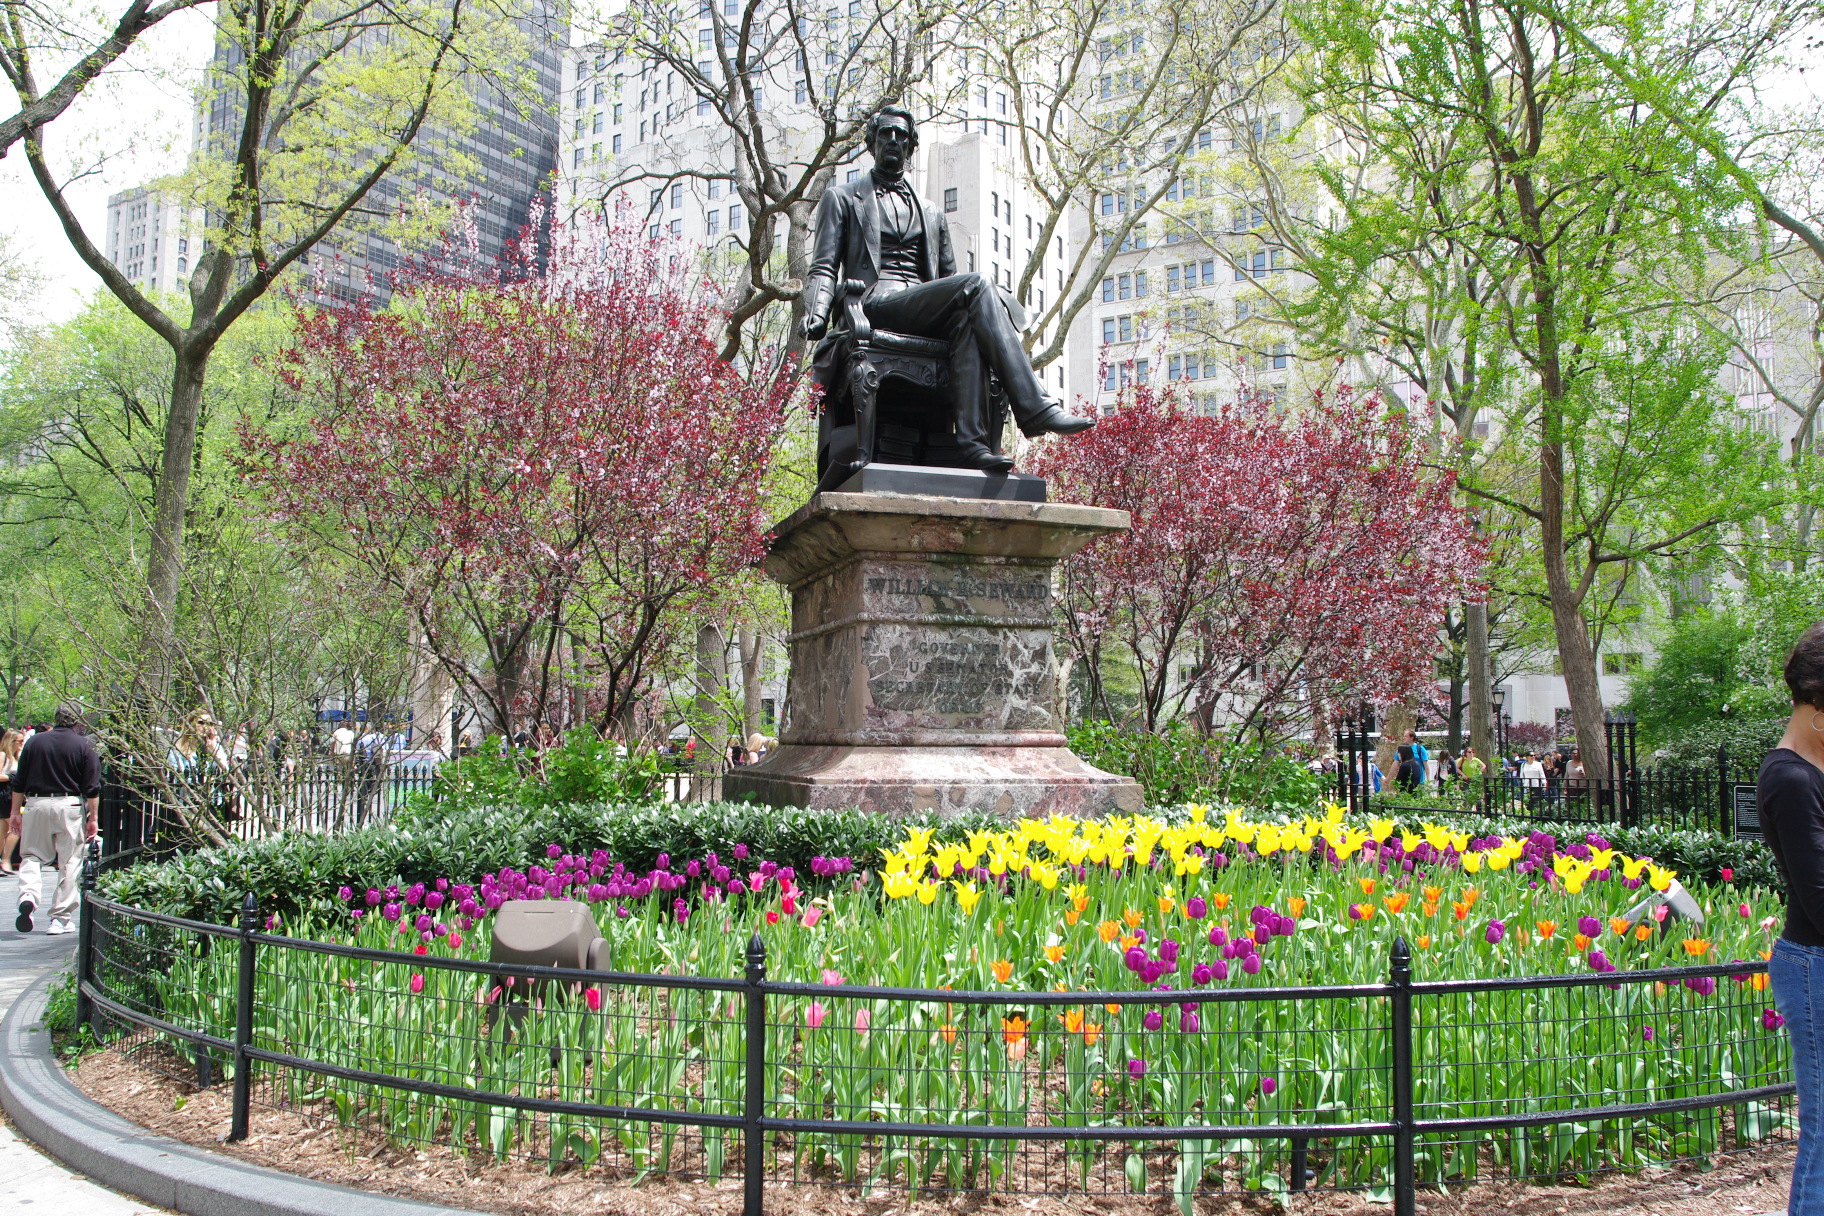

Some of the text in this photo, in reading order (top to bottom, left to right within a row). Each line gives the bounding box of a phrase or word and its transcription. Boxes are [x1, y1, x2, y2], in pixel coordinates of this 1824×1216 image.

[868, 577, 951, 596] WILLIAM
[975, 582, 1048, 599] SEWARD
[919, 641, 1000, 655] GOVERNOR
[938, 661, 1009, 675] SENATOR
[876, 680, 965, 693] SECRETARY
[994, 683, 1041, 696] STATE
